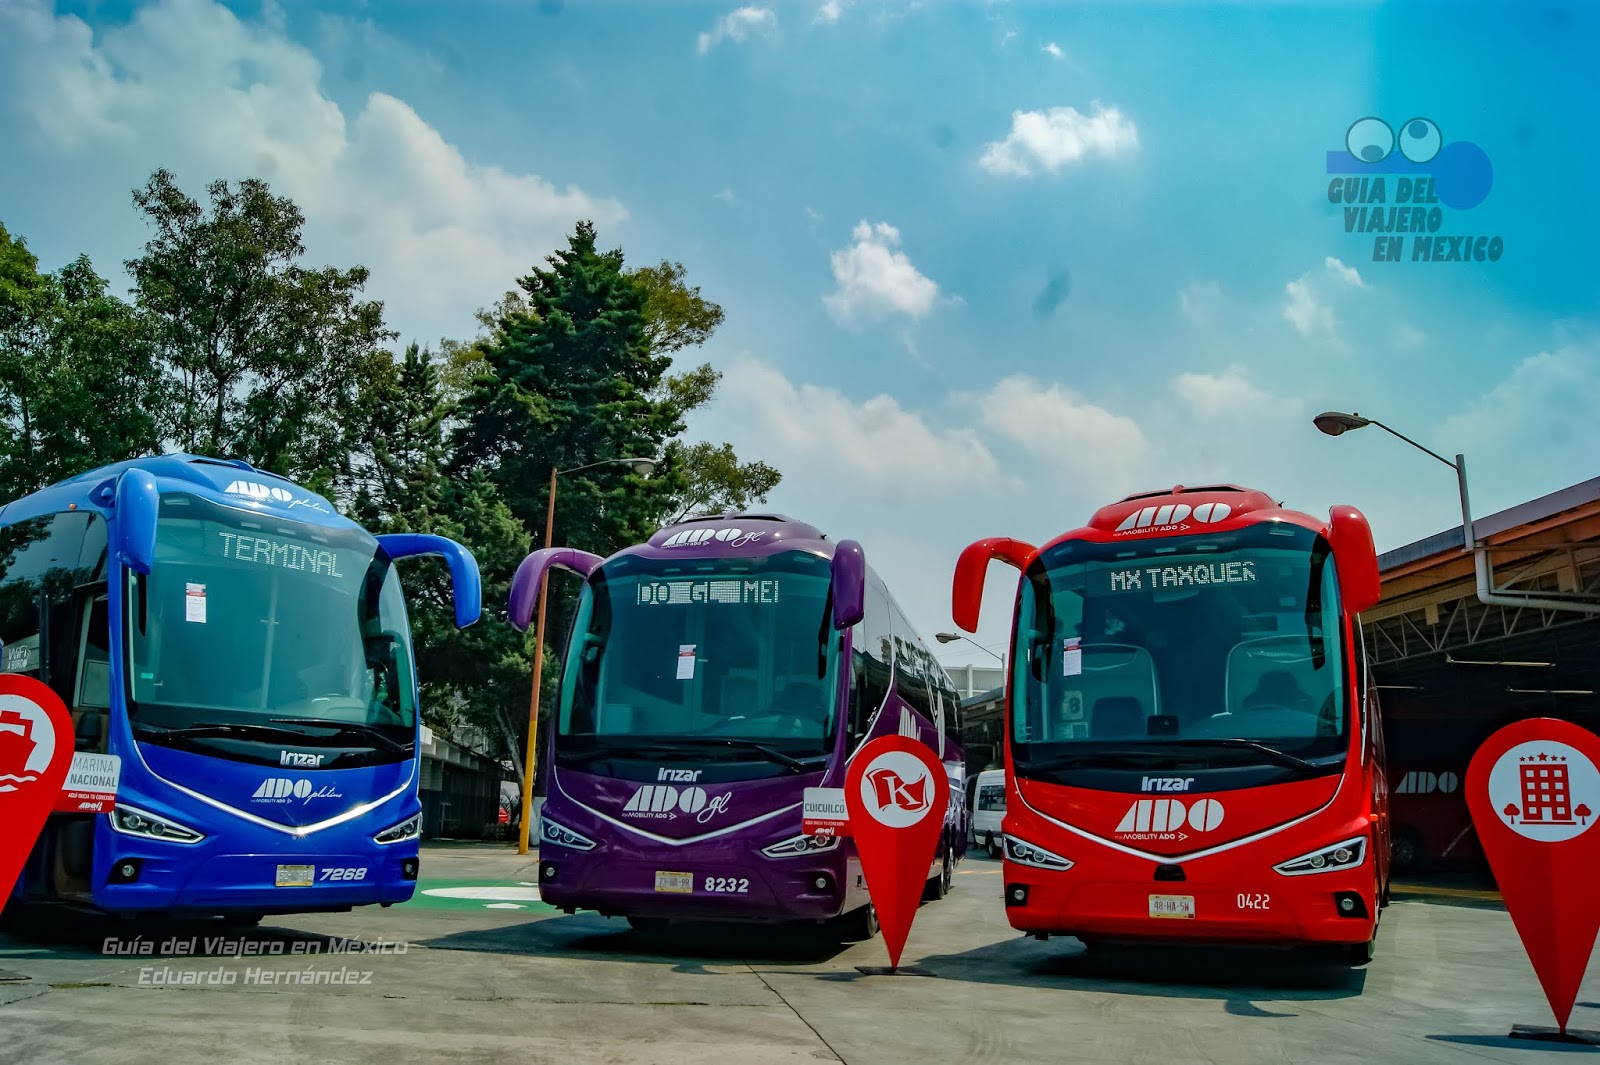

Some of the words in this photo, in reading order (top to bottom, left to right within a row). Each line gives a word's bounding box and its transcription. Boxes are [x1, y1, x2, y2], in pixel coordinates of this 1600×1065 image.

[224, 480, 293, 502] ADO
[1114, 502, 1232, 532] ADO
[661, 528, 742, 547] ADO
[1121, 526, 1159, 536] MOBILITY
[219, 531, 343, 578] TERMINAL
[1110, 569, 1142, 591] MX
[73, 757, 114, 773] MARINA
[280, 750, 324, 767] Irizar
[70, 774, 116, 787] NACIONAL
[657, 767, 702, 782] Irizar
[1395, 771, 1458, 794] ADO
[252, 778, 312, 798] ADO
[1141, 776, 1194, 791] Irizar
[622, 785, 707, 813] ADO
[804, 802, 845, 814] CUICUILCO
[1115, 799, 1225, 832] ADO
[319, 867, 367, 881] 7268
[704, 876, 750, 893] 8232
[1236, 893, 1270, 909] 0422
